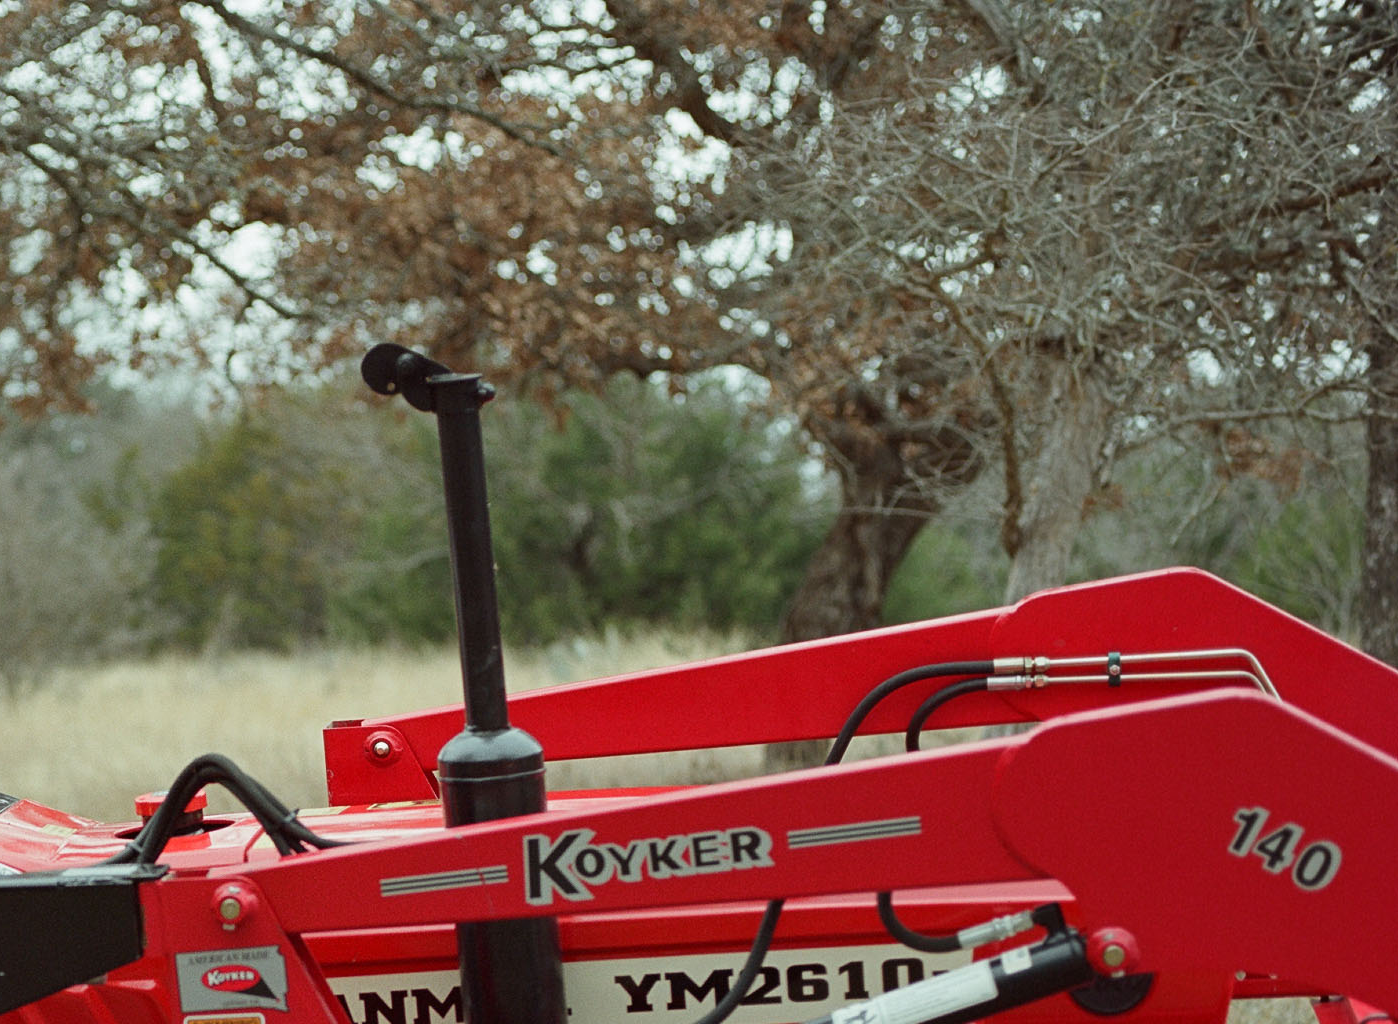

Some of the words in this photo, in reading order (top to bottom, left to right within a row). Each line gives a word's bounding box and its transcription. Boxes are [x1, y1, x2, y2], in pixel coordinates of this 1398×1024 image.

[523, 828, 774, 905] KOYKER
[1228, 806, 1342, 890] 140
[614, 957, 950, 1013] YM2610
